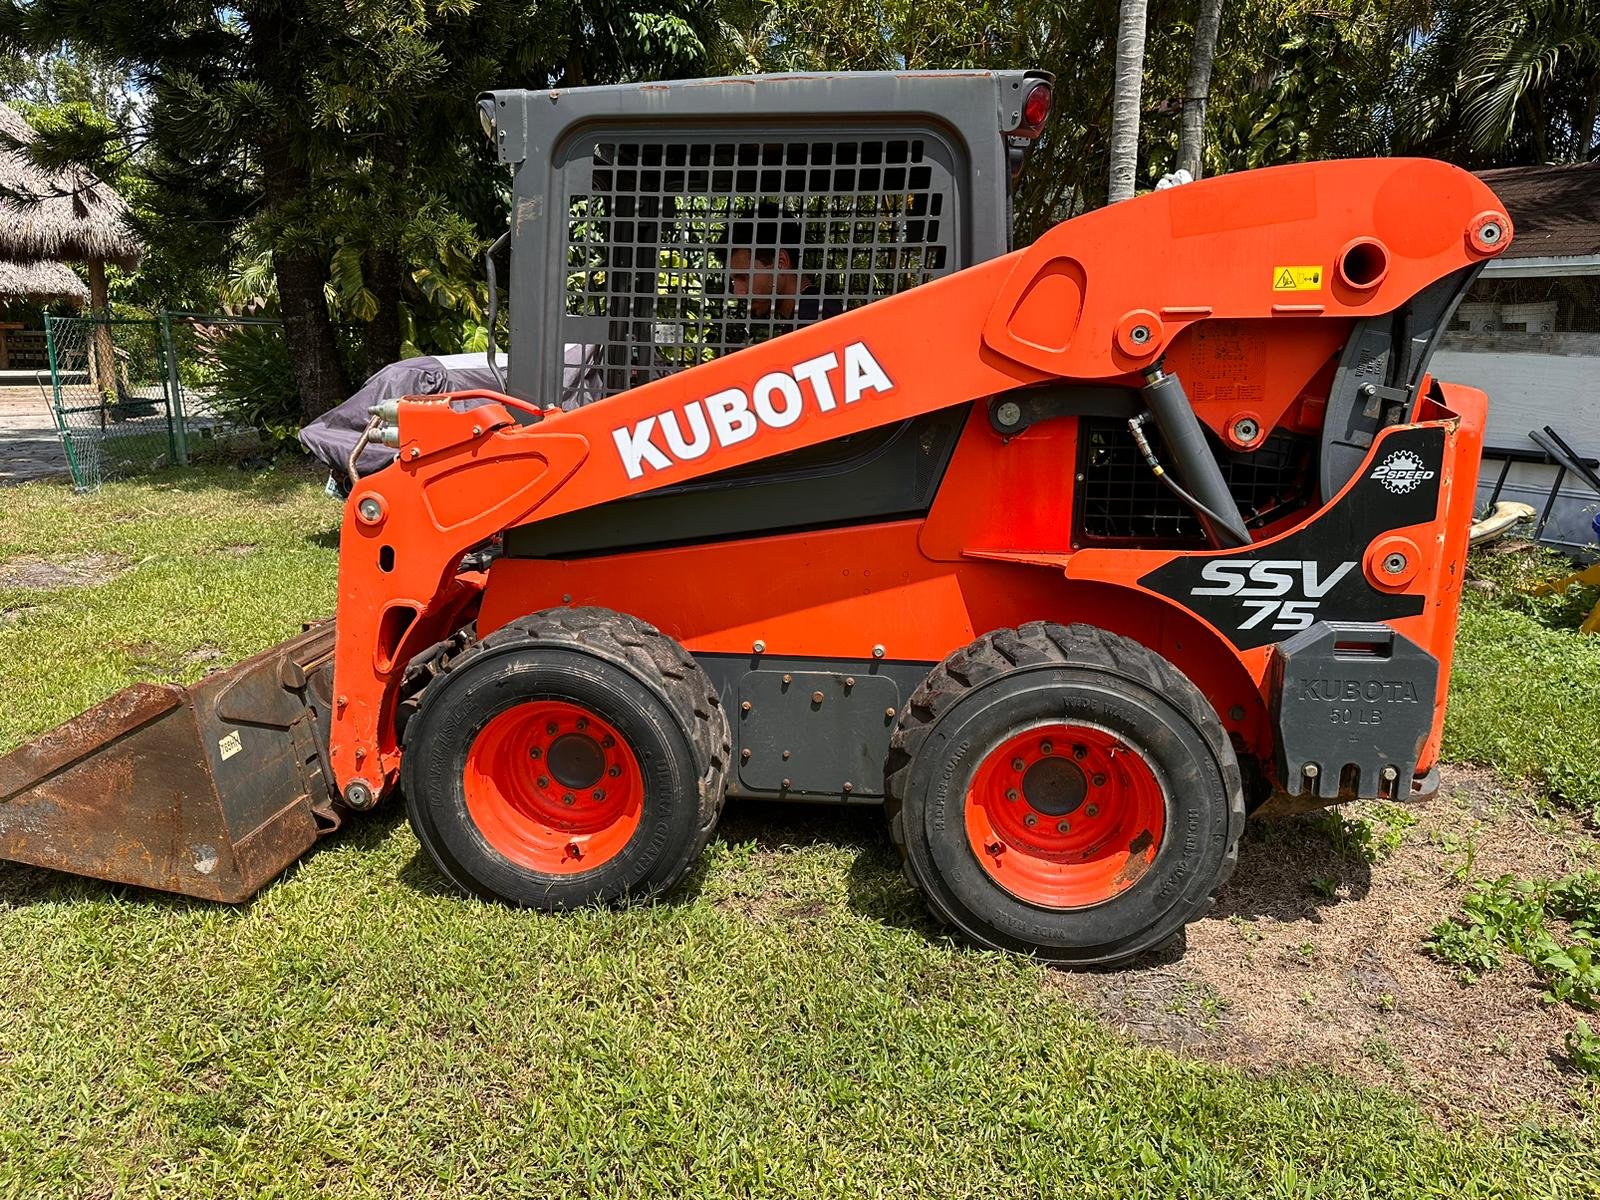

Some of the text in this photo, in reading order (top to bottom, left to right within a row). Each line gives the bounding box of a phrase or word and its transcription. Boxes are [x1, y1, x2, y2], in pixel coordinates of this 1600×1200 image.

[611, 341, 894, 480] KUBOTA
[1190, 559, 1358, 598] SSV
[1236, 600, 1320, 631] 75
[1062, 694, 1099, 711] WIDE
[1298, 678, 1420, 704] KUBOTA
[1330, 708, 1383, 725] 50 LB
